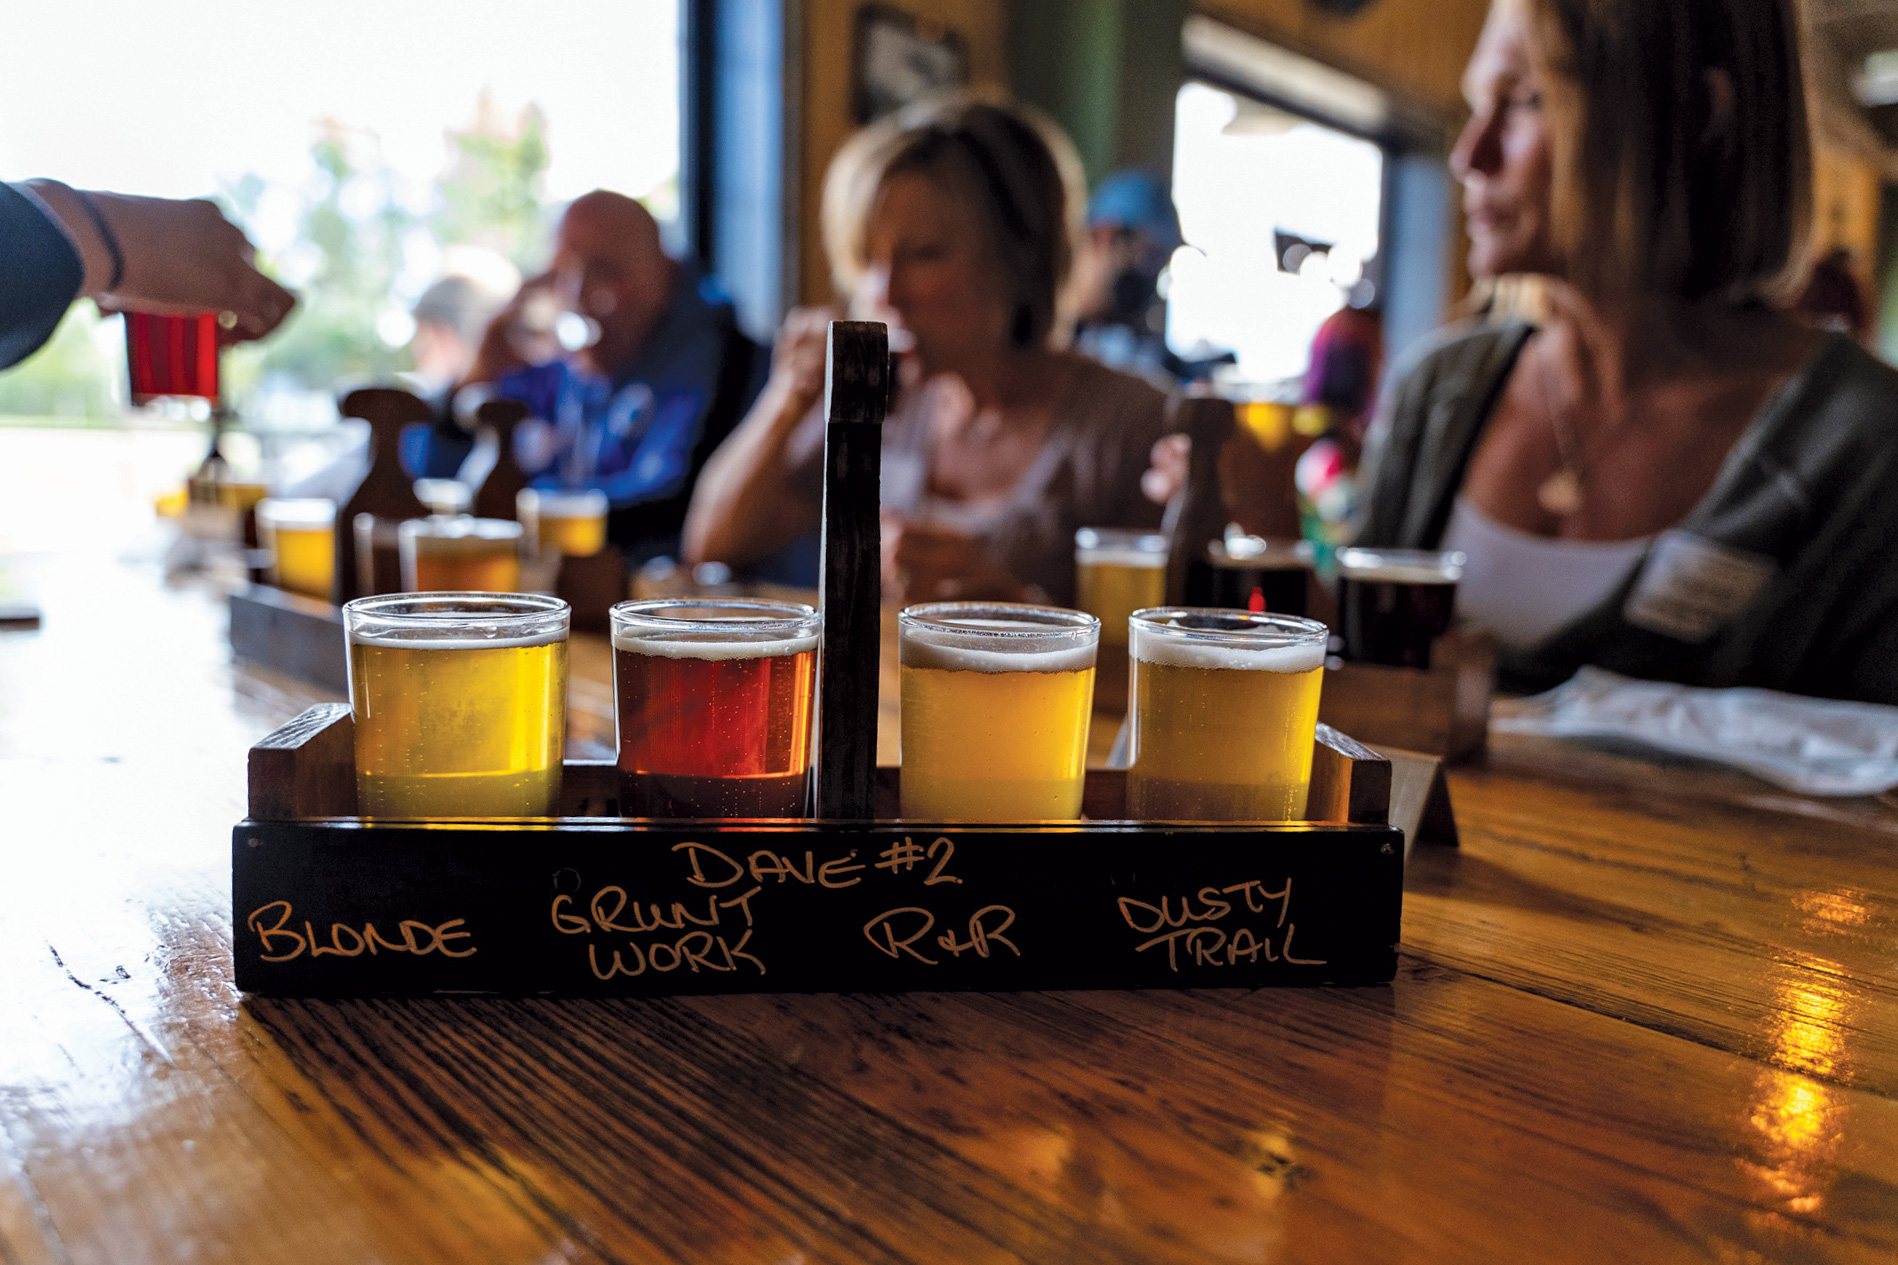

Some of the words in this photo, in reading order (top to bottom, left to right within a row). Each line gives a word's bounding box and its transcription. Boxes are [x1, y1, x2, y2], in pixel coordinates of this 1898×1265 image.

[671, 841, 866, 889] DAVE
[874, 836, 963, 887] #2
[247, 900, 478, 962] BLONDE
[551, 885, 762, 934] GRUNT
[1117, 877, 1292, 933] DUSTY
[588, 930, 767, 981] WORK
[1135, 923, 1328, 973] TRAIL
